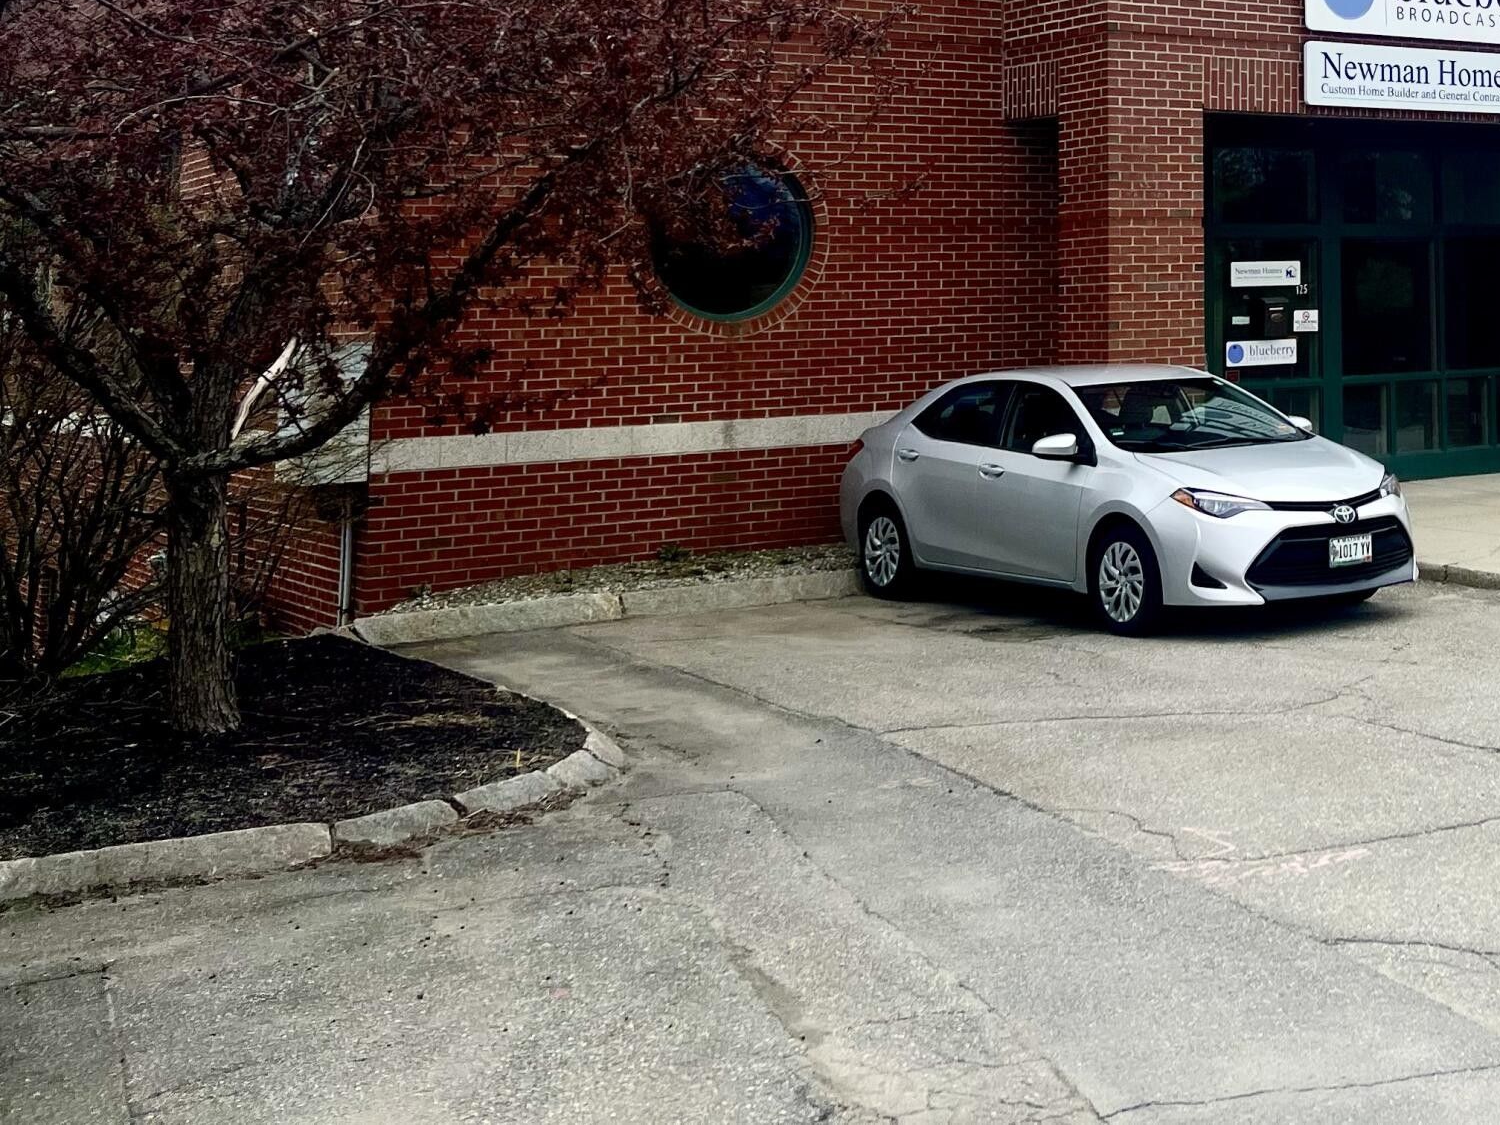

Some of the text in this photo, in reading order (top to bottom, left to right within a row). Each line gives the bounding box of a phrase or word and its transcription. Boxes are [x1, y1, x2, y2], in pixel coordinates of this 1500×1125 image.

[1320, 51, 1430, 84] Newman
[1321, 83, 1356, 95] Custom
[1358, 85, 1385, 97] Home
[1387, 86, 1419, 99] Builder
[1421, 88, 1436, 100] and
[1438, 89, 1471, 101] General
[1296, 284, 1308, 295] 125
[1249, 345, 1295, 357] blueberry
[1339, 543, 1358, 558] 1017
